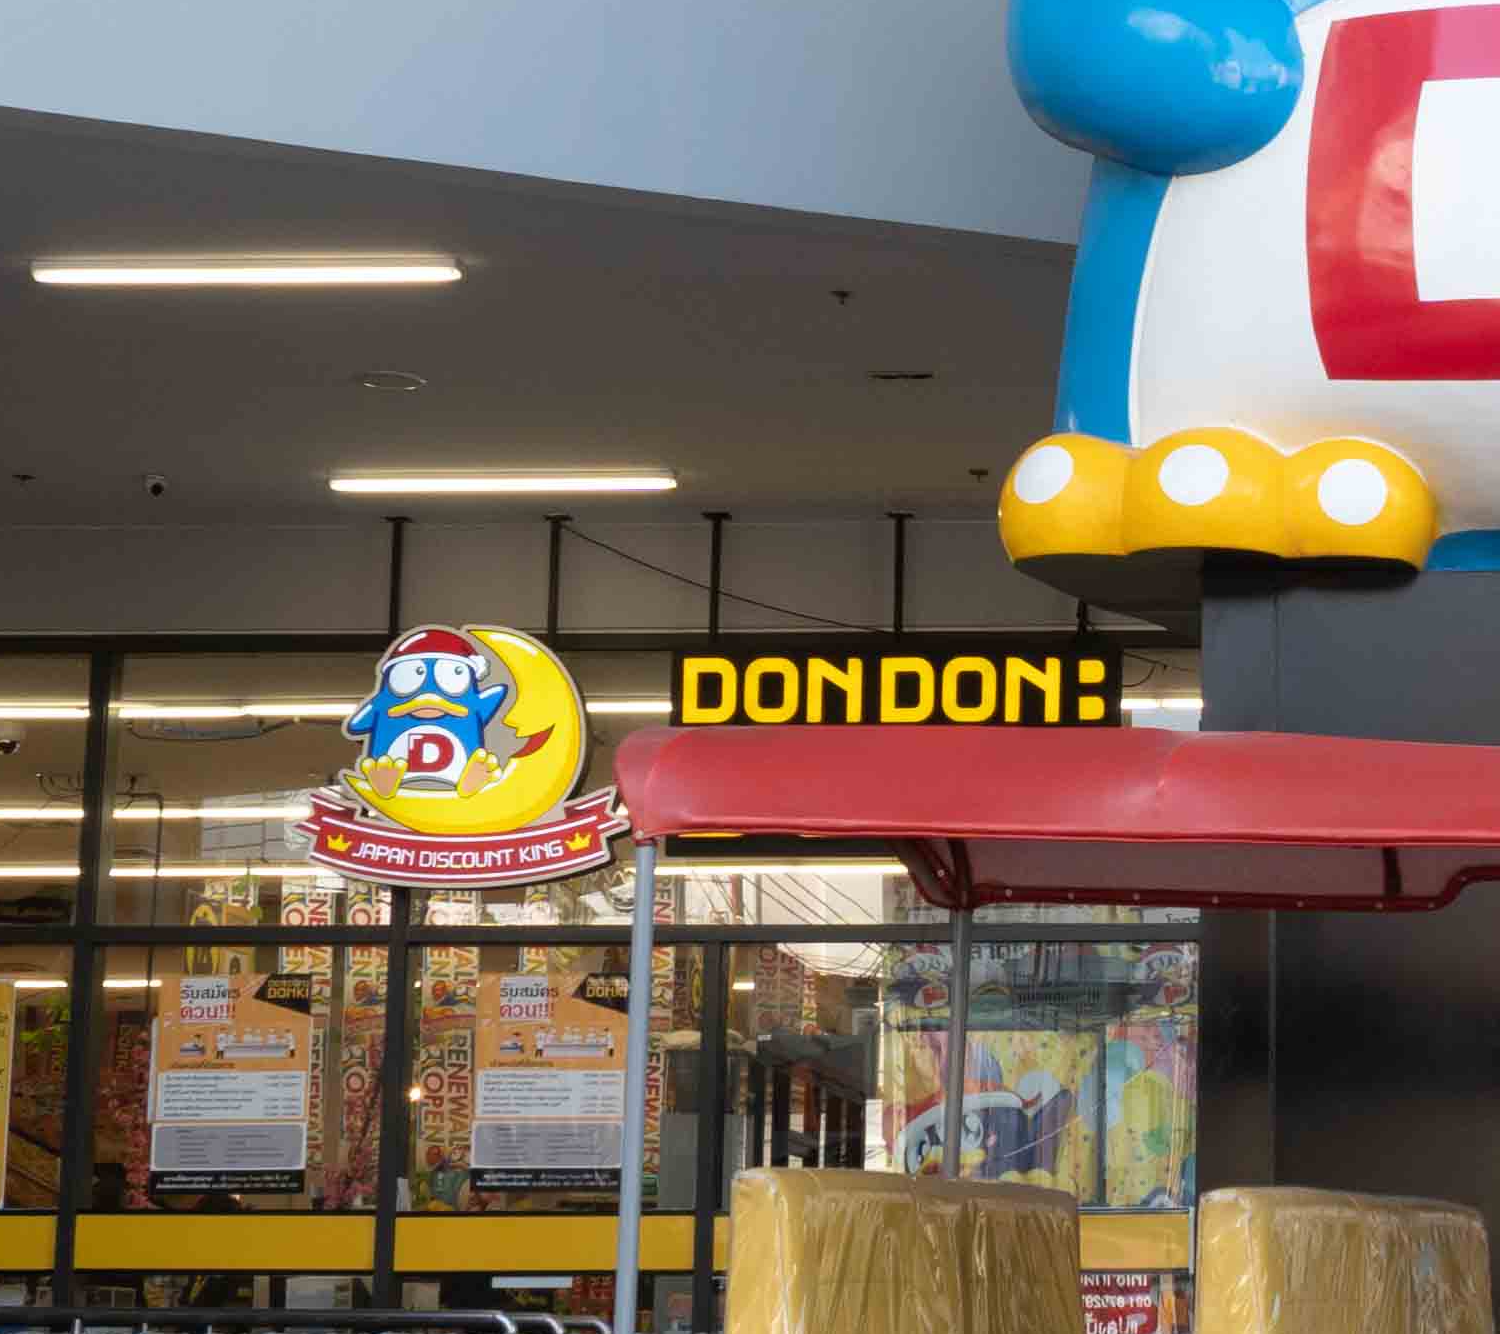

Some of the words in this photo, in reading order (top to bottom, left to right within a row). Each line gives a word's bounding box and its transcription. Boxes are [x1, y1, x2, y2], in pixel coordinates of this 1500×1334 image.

[352, 841, 416, 865] JAPAN
[419, 847, 515, 868] DISCOUNT
[519, 838, 564, 863] KING
